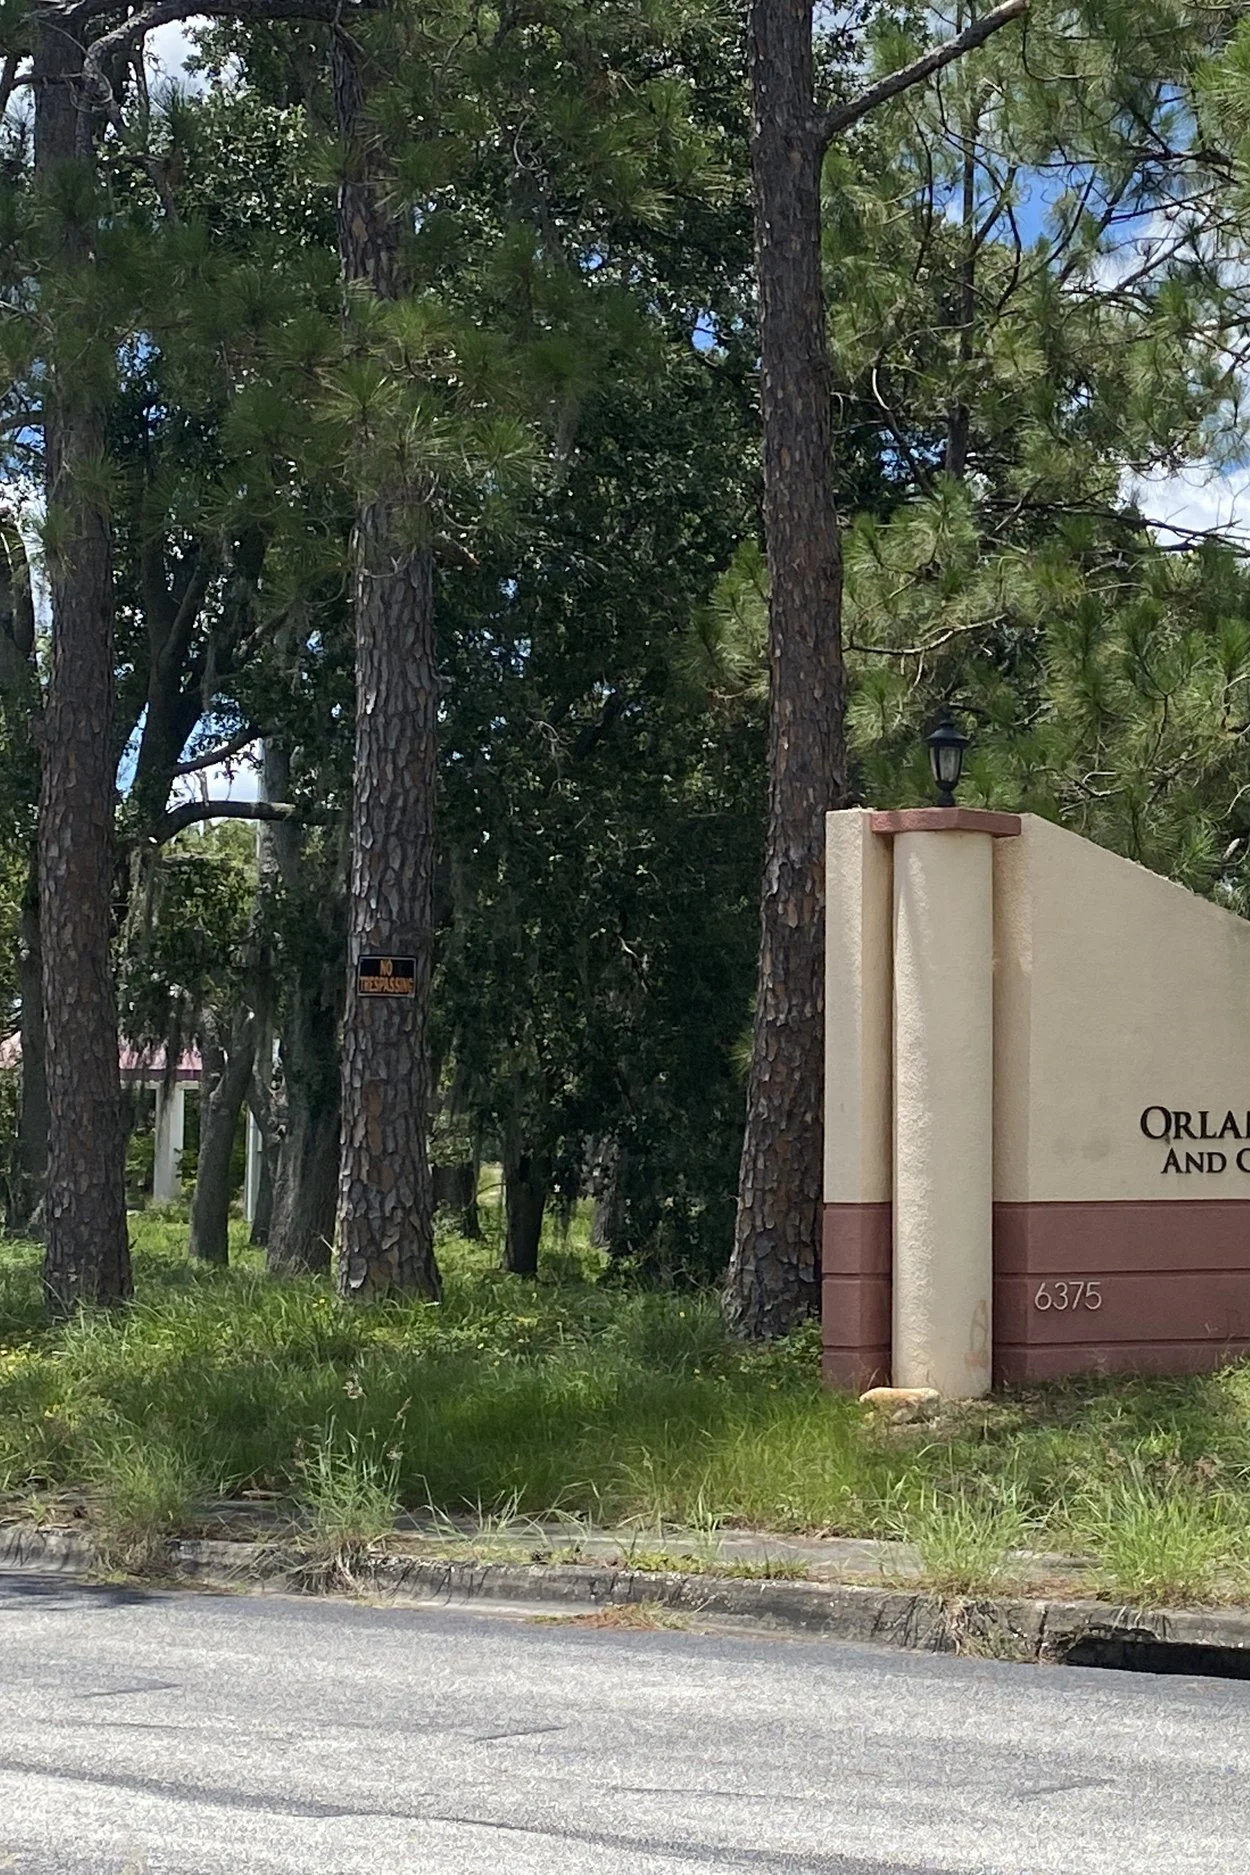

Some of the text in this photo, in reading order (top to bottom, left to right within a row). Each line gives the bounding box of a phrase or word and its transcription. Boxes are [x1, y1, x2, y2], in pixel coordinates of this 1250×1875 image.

[380, 959, 393, 976] NO
[359, 976, 414, 993] TRESPASSING
[1161, 1148, 1227, 1174] AND
[1034, 1281, 1102, 1310] 6375
